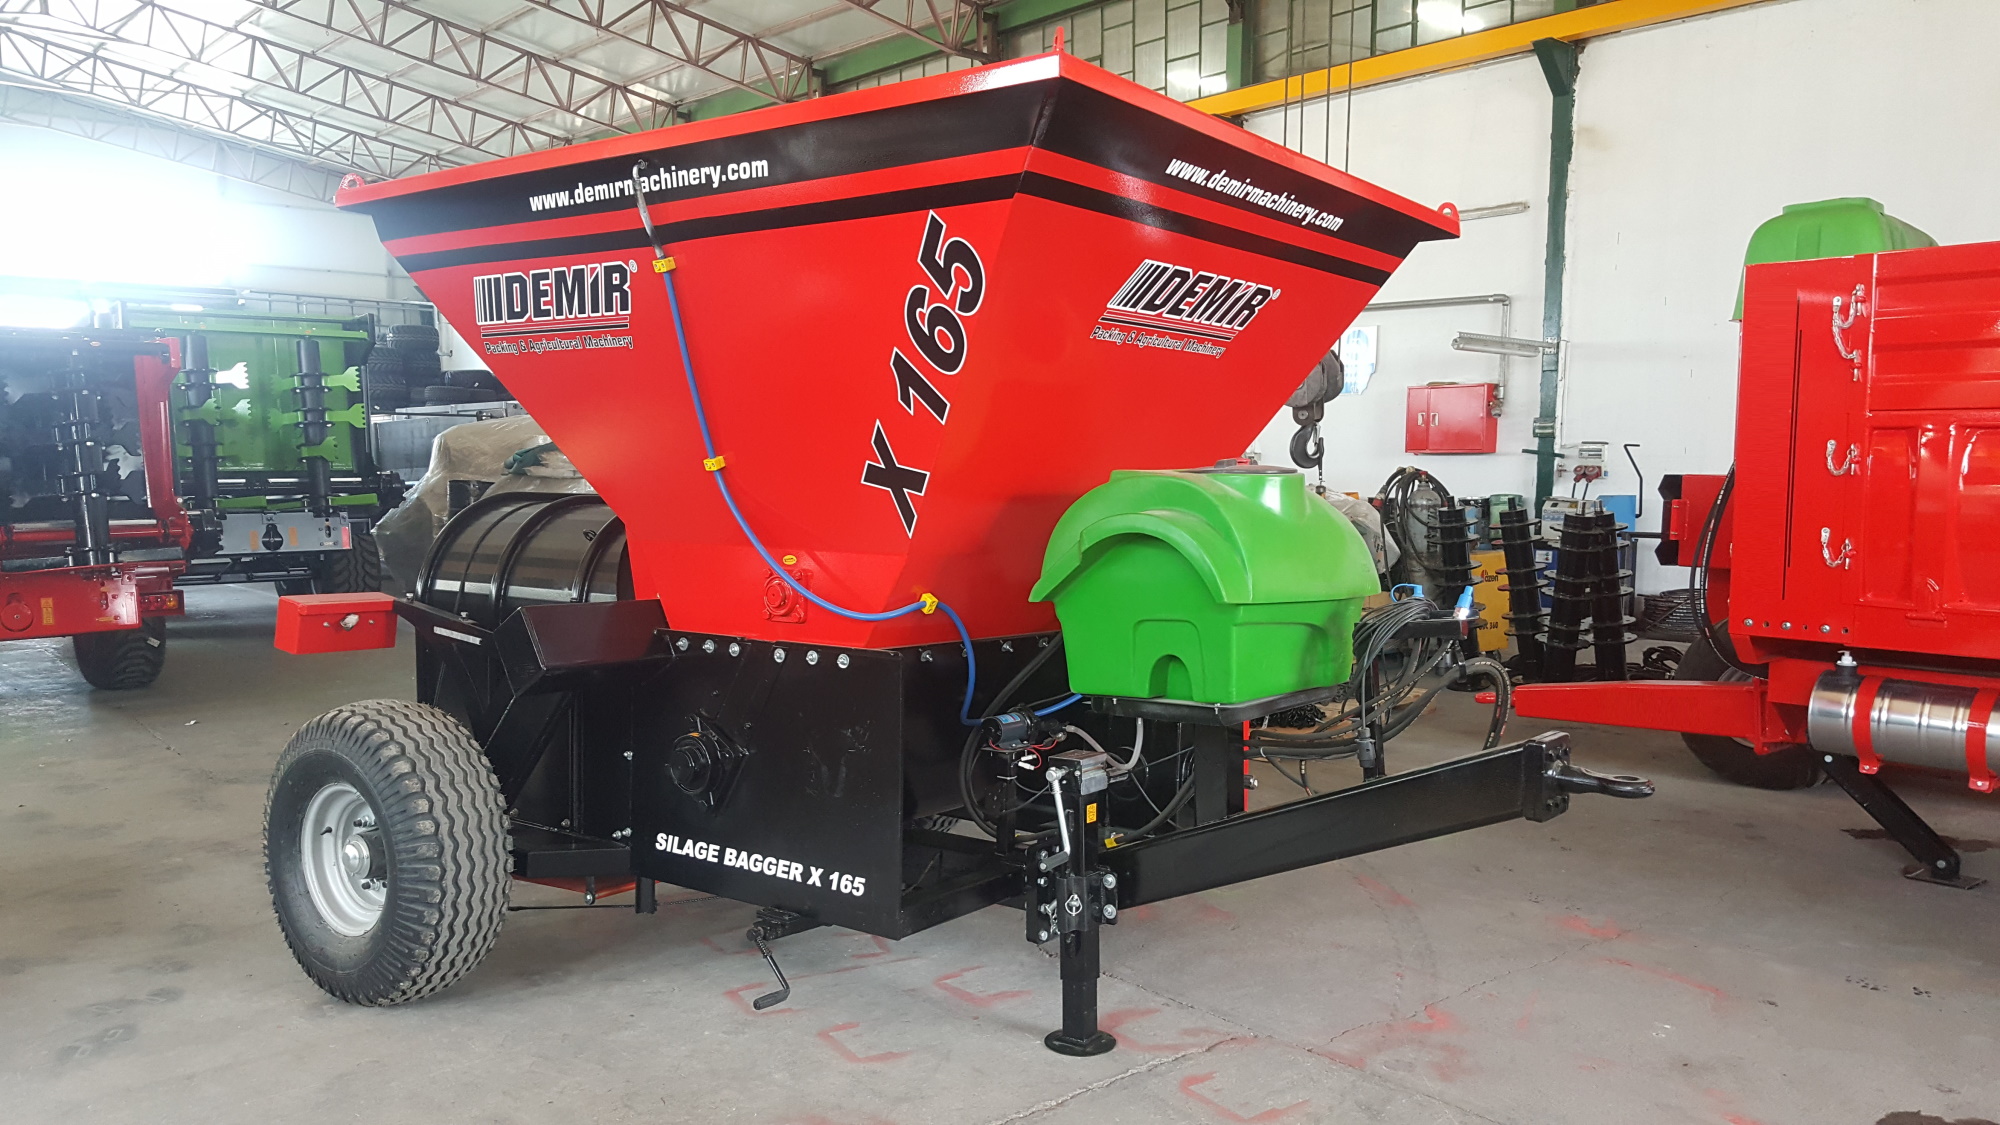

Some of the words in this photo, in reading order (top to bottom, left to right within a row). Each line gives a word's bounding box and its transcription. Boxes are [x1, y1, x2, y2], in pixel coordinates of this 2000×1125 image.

[1165, 158, 1345, 232] www.demirmachinery.com
[483, 339, 519, 355] Packing
[519, 340, 528, 352] &
[529, 336, 582, 354] Agricultural
[582, 334, 633, 350] Machinery
[890, 209, 986, 426] 165
[1090, 325, 1127, 346] Packing
[1126, 330, 1136, 344] &
[1134, 331, 1185, 350] Agricultural
[1184, 340, 1227, 359] Machinery
[861, 418, 931, 539] X
[655, 832, 721, 864] SILAGE
[723, 847, 804, 883] BAGGER
[806, 866, 824, 888] X
[828, 871, 866, 897] 165
